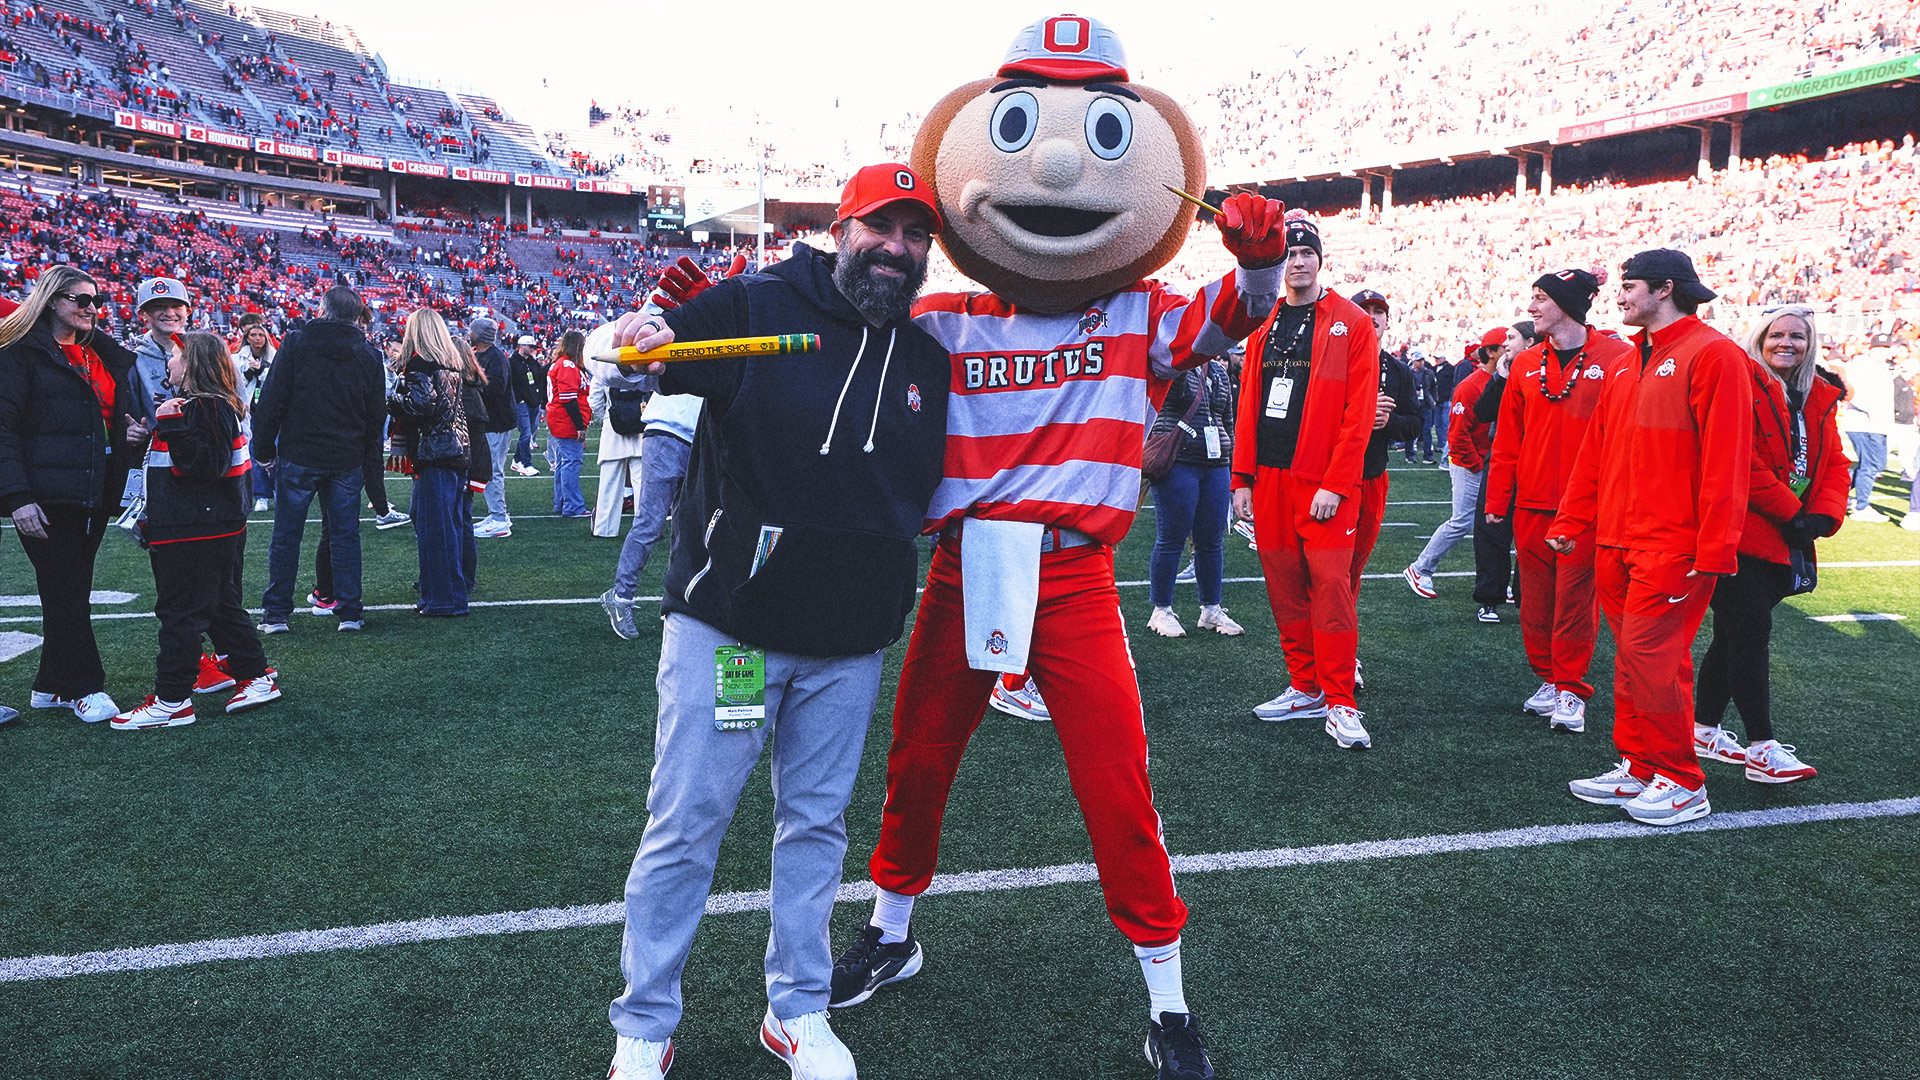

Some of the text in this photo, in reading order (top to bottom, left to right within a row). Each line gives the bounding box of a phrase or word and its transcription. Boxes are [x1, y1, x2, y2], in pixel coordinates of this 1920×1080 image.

[1042, 16, 1092, 55] O
[1774, 61, 1908, 100] CONGRATULATIONS
[1670, 110, 1680, 119] IN
[1682, 105, 1700, 116] THE
[1702, 100, 1730, 113] LAND
[120, 114, 175, 136] 10 SMITH
[190, 128, 249, 148] 22 HORVATH
[259, 141, 314, 159] 27 GEORGE
[327, 152, 383, 169] 31 JANOWICZ
[392, 161, 445, 176] 40 CASSADY
[455, 169, 507, 183] 45 GRIFFIN
[517, 175, 568, 189] 47 HARLEY
[894, 170, 915, 191] O
[578, 181, 590, 190] 99
[669, 344, 751, 358] DEFEND THE 'SHOE
[964, 340, 1105, 390] BRUTUS
[725, 669, 754, 678] DAY OF GAME
